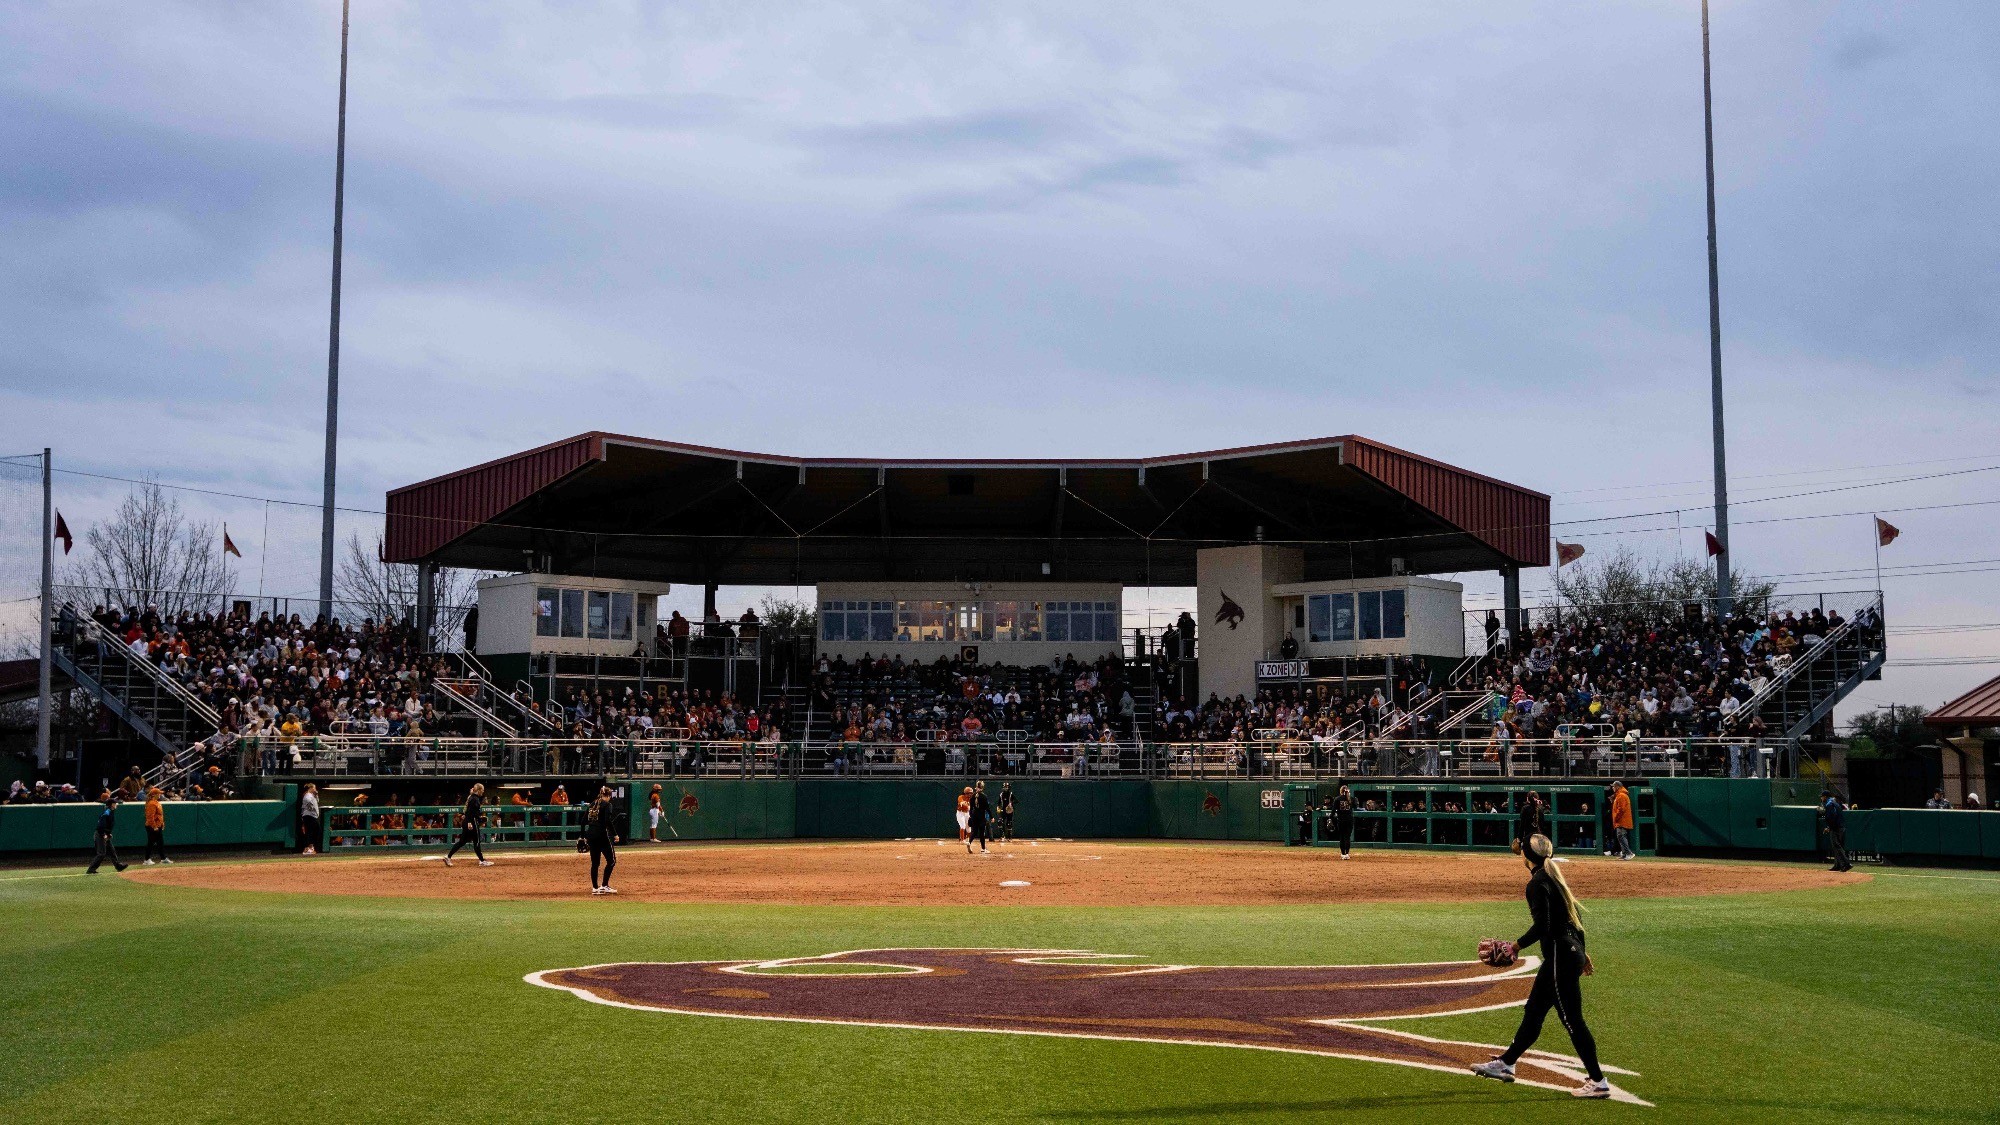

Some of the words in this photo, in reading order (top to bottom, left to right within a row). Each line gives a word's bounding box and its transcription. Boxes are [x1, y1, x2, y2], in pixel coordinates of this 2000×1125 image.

[963, 647, 976, 662] C
[1259, 664, 1265, 676] K
[1266, 663, 1288, 676] ZONE
[657, 684, 668, 699] B
